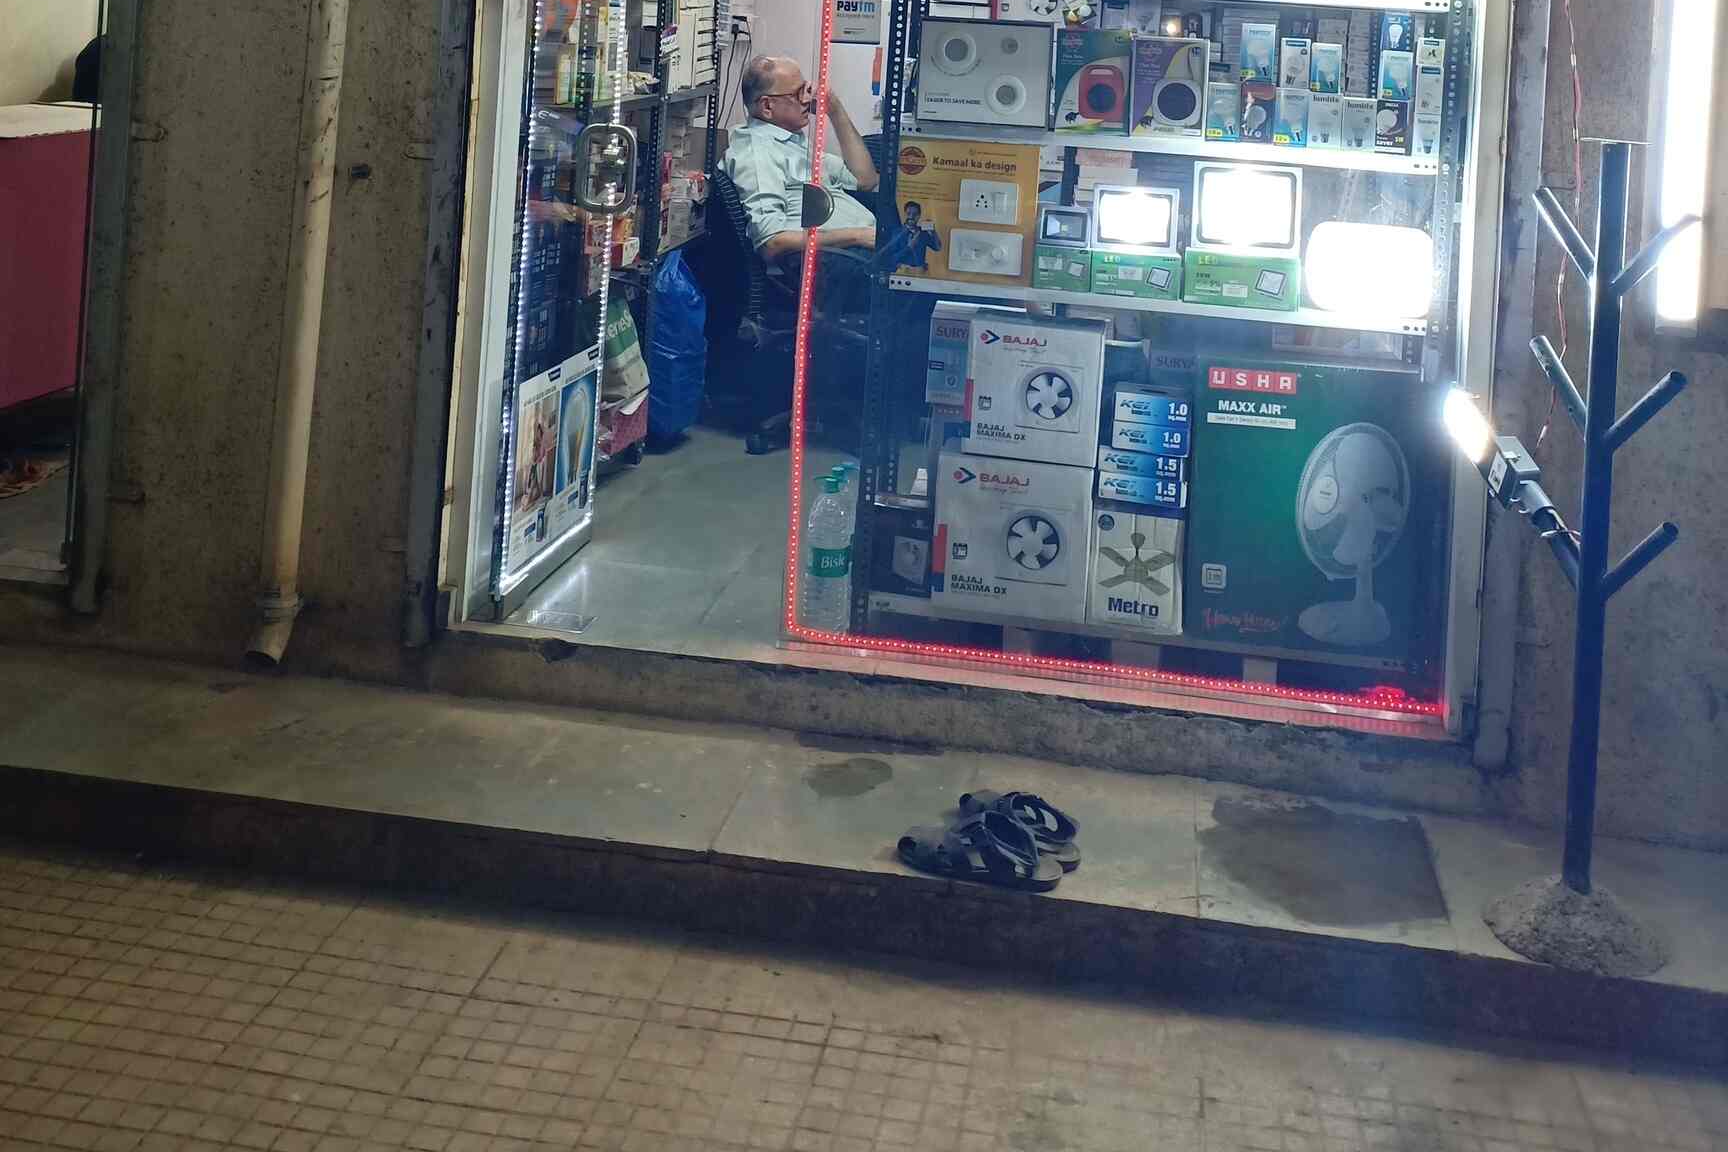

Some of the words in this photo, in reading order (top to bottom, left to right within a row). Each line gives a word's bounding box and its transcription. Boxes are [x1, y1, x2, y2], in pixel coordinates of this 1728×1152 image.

[932, 155, 969, 168] Kamaal
[971, 158, 983, 169] ka
[984, 160, 1017, 173] design
[1002, 334, 1048, 347] BAJAJ
[1212, 370, 1293, 390] USHA
[1167, 402, 1188, 417] 1.0
[1218, 399, 1256, 414] MAXX
[1162, 431, 1181, 445] 1.0
[1155, 456, 1177, 472] 1.5
[979, 472, 1030, 487] BAJAJ
[1155, 480, 1177, 496] 1.5
[950, 573, 983, 585] BAJAJ
[950, 582, 991, 593] MAXIMA
[1107, 596, 1160, 617] Metro
